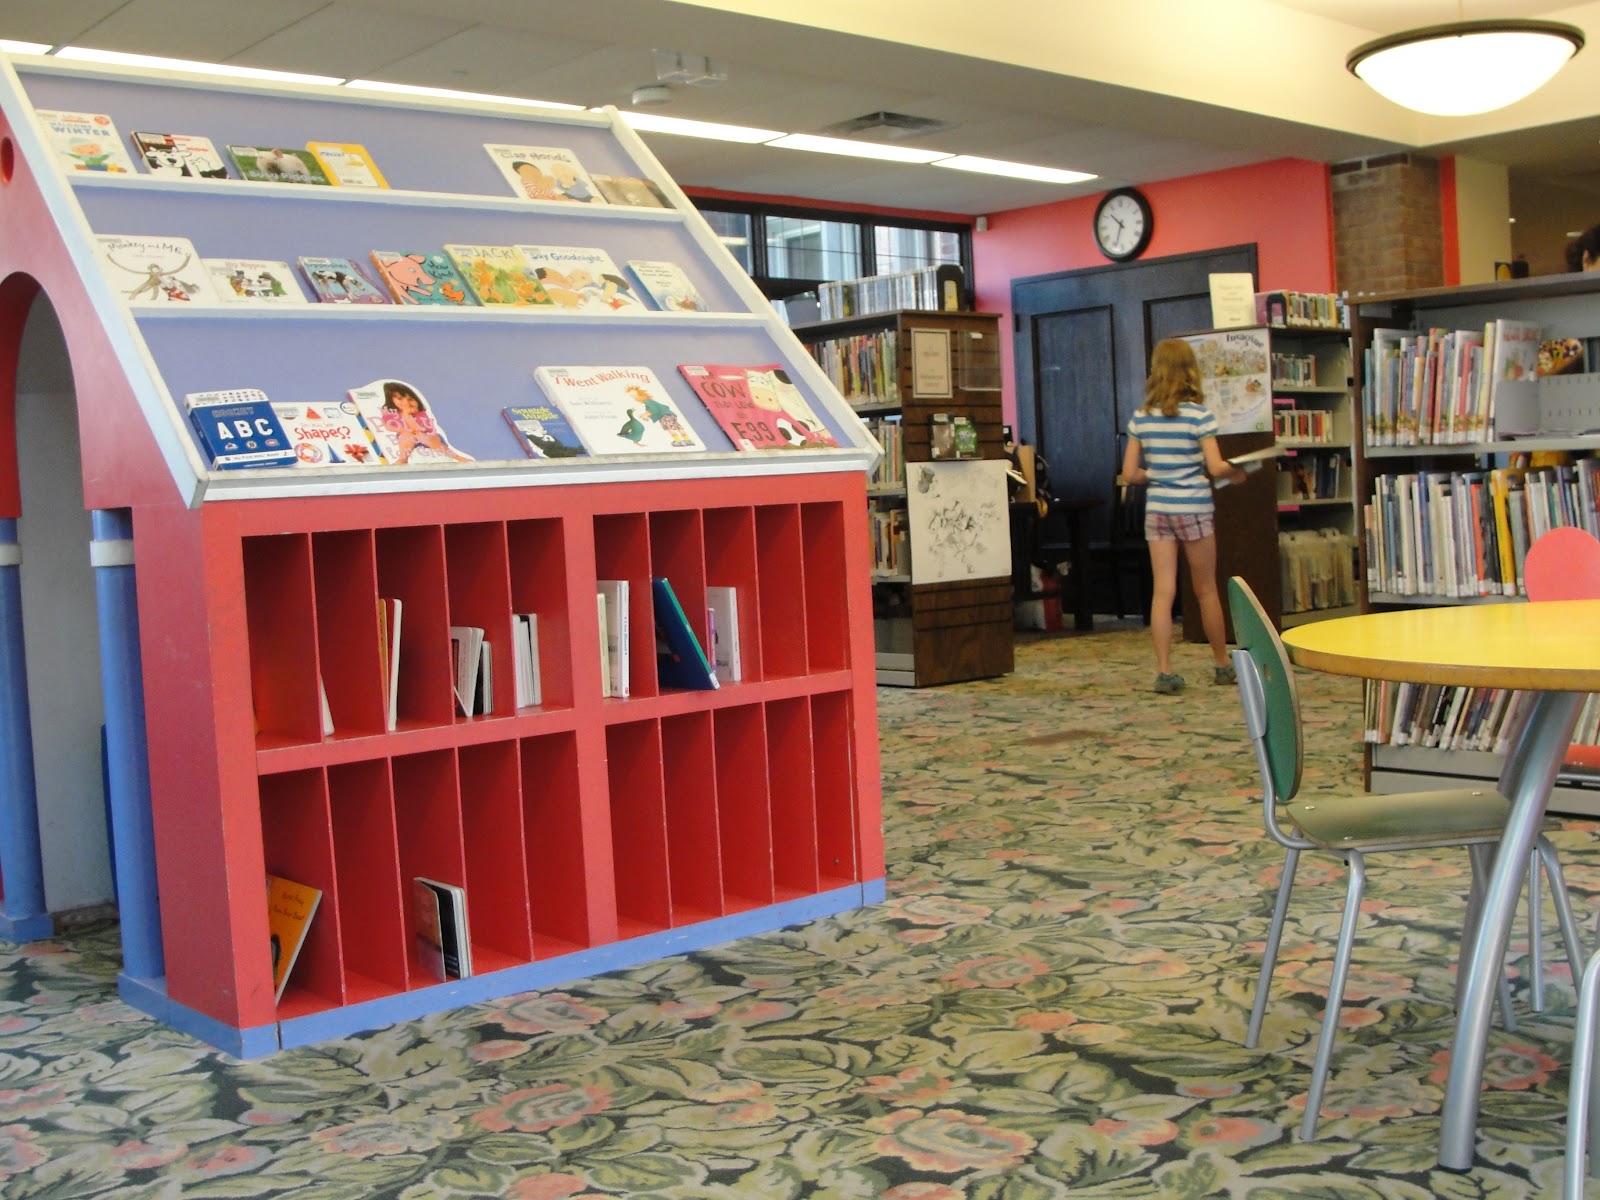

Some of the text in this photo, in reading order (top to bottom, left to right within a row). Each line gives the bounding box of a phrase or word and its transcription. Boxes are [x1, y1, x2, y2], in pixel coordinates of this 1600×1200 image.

[52, 126, 111, 137] WINTER
[562, 377, 600, 387] Went
[595, 369, 651, 384] Walking
[701, 381, 746, 398] COW
[217, 418, 273, 440] ABC
[294, 425, 351, 441] Shapes?
